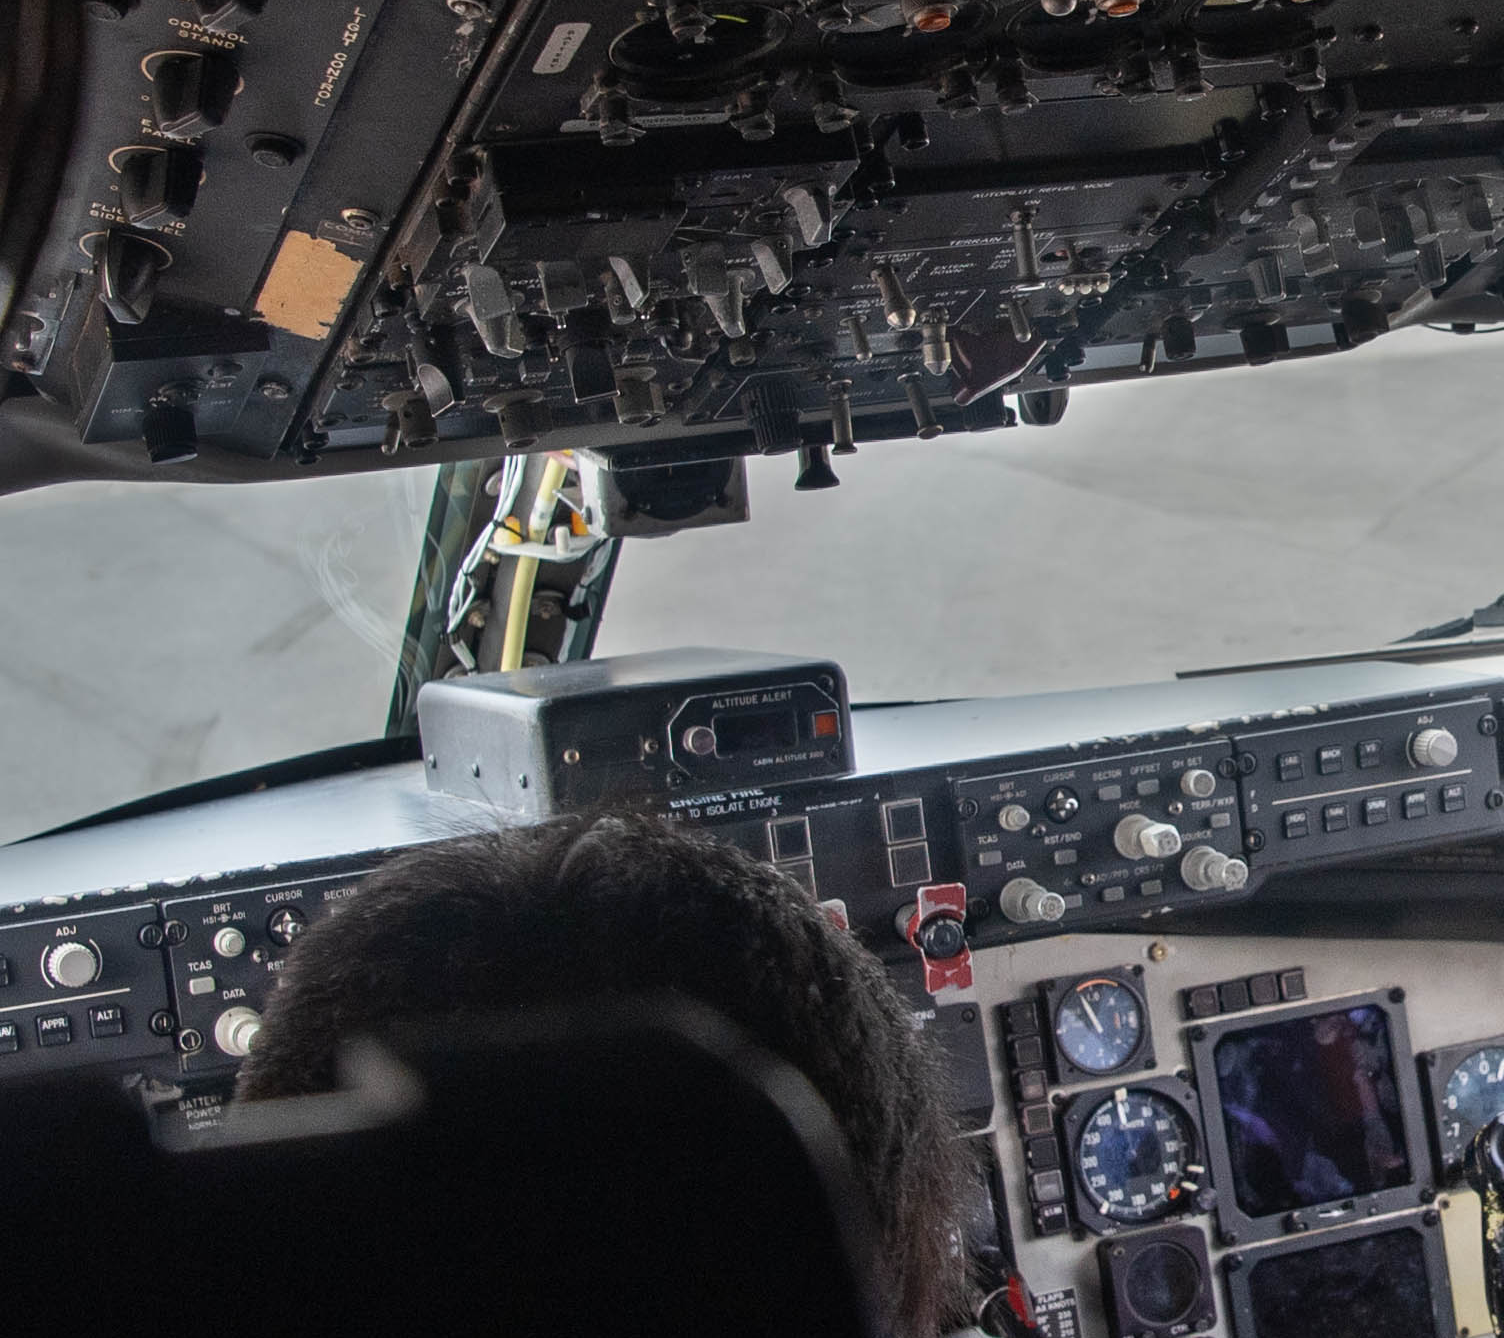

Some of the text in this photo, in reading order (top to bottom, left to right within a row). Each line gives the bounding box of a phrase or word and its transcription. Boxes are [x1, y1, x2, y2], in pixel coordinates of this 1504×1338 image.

[168, 17, 249, 44] CONTROL
[178, 30, 236, 50] STAND
[314, 7, 367, 108] LIGHT CONTROL
[971, 188, 1037, 200] AUTOPILOT
[711, 690, 793, 709] ALTITUDE ALERT
[689, 796, 783, 819] TO ISOLATE ENGINE
[1006, 860, 1026, 871] DATA
[265, 889, 303, 904] CURSOR
[213, 902, 232, 914] BRT
[56, 925, 77, 938] ADJ
[187, 960, 213, 972] TCAS
[222, 988, 246, 1000] DATA
[41, 1017, 65, 1030] APPR
[97, 1009, 114, 1021] ALT
[186, 1106, 222, 1120] POWER
